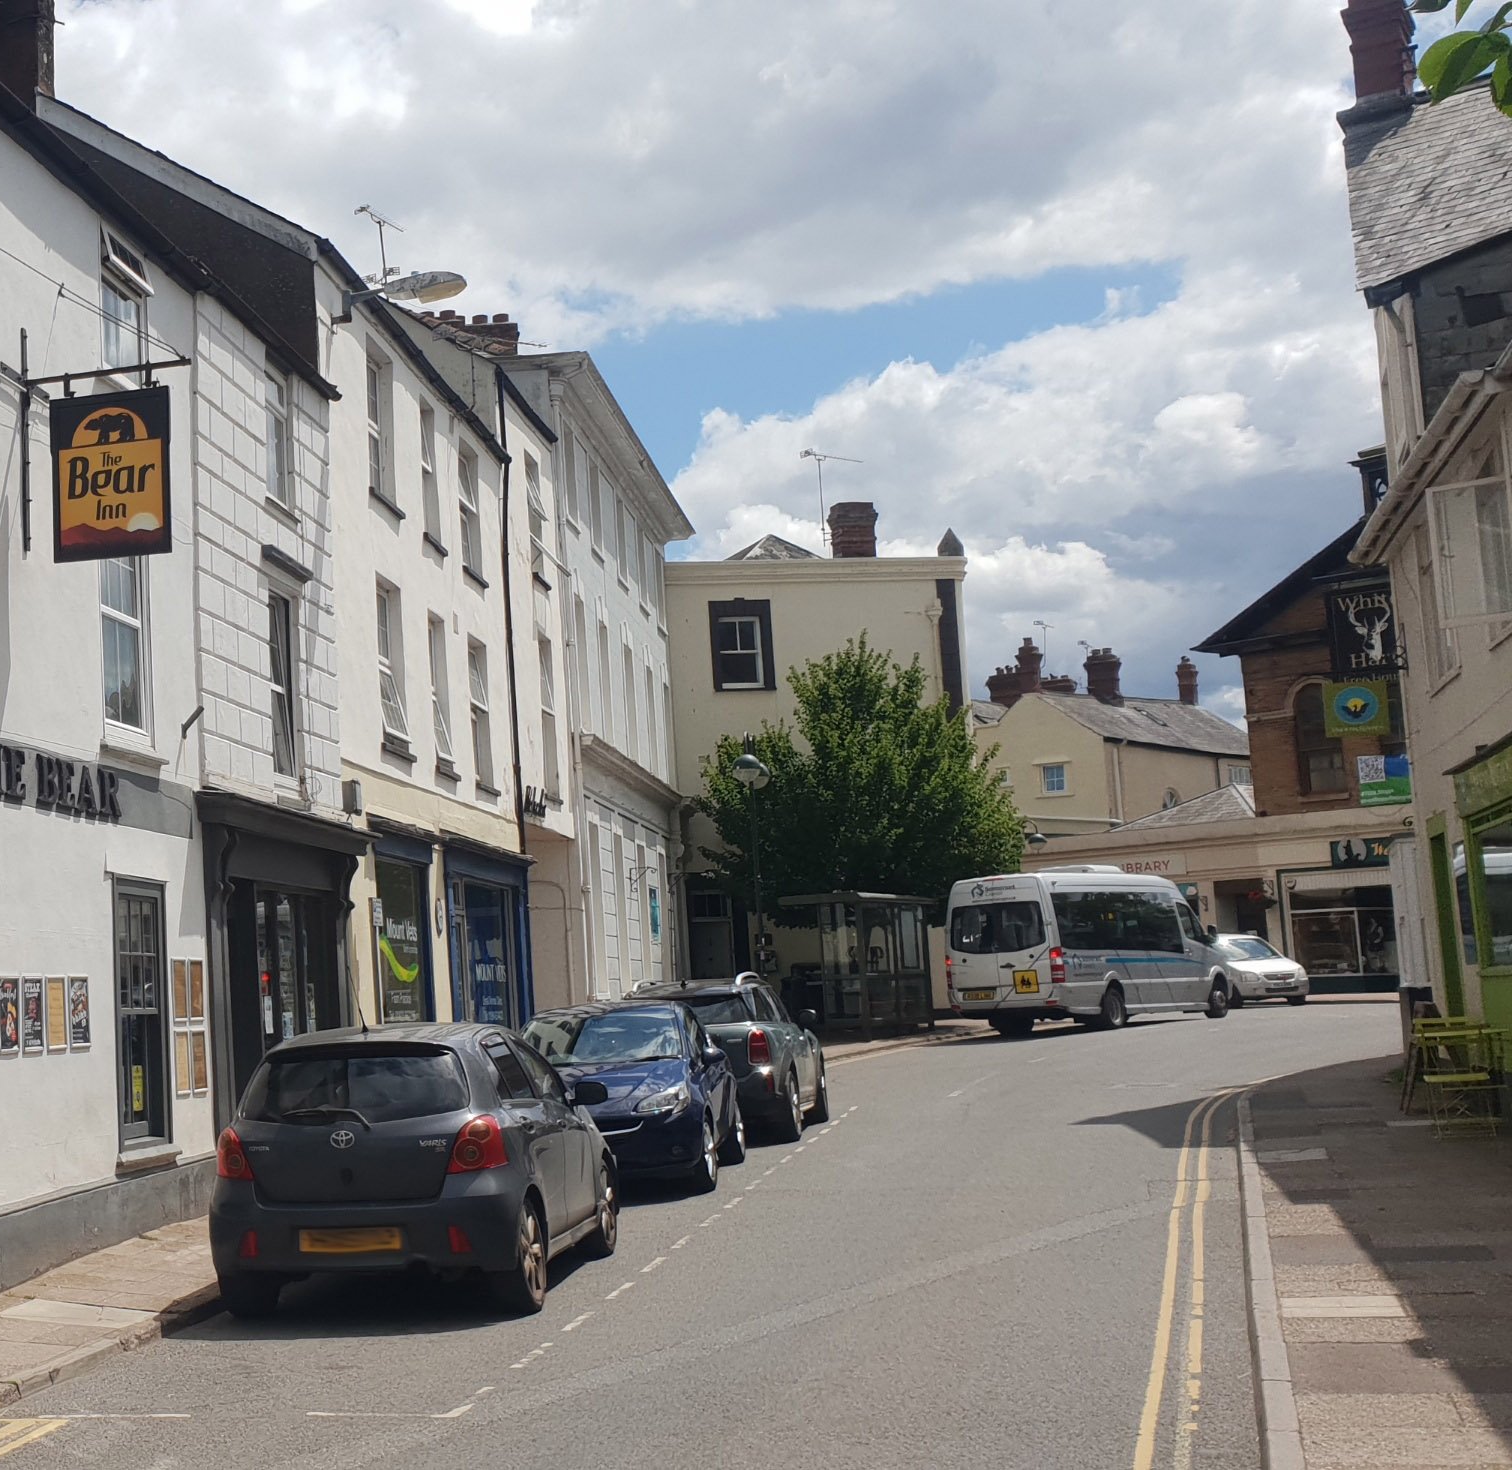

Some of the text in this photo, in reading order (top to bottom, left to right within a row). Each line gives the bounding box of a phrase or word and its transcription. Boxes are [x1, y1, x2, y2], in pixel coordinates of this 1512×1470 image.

[100, 451, 123, 468] The
[66, 455, 156, 500] Bear
[95, 499, 127, 521] Inn
[35, 752, 123, 818] BEAR
[1120, 859, 1170, 874] IBRARY
[386, 917, 419, 942] Mount Vets
[475, 963, 494, 982] MOUNT
[418, 1138, 448, 1148] YARIS
